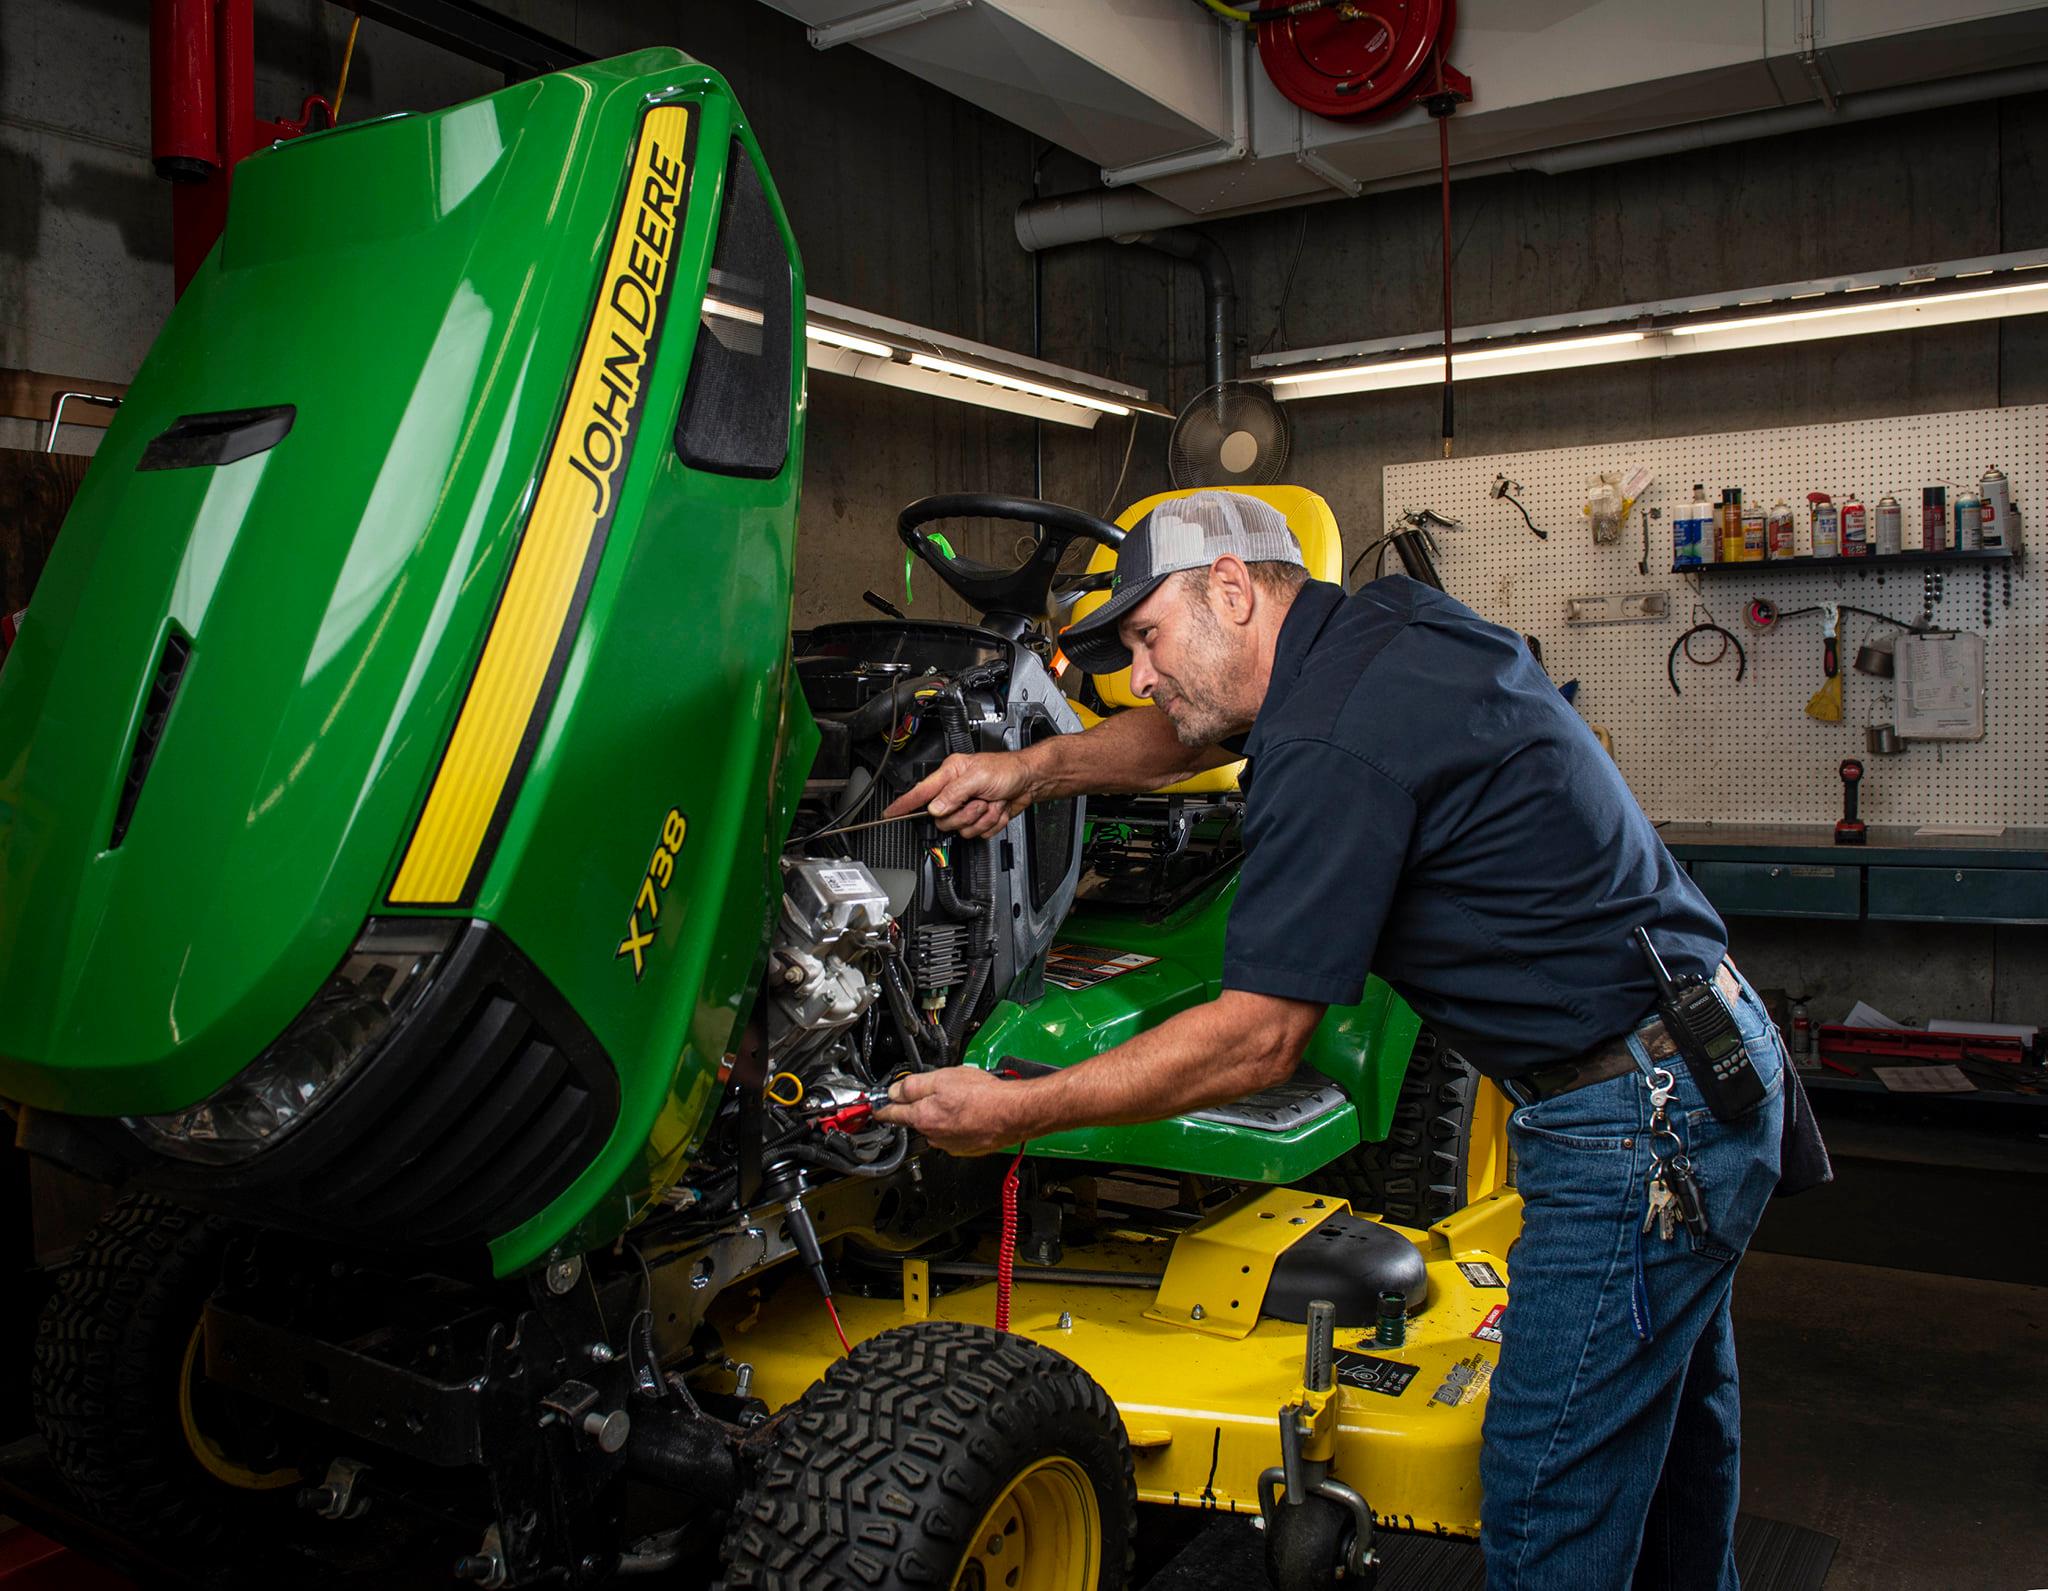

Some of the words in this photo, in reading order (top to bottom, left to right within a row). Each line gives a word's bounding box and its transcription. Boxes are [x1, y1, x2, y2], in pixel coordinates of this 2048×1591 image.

[568, 331, 643, 515] JOHN
[612, 140, 684, 337] DEERE
[616, 807, 688, 981] X738
[1432, 1363, 1476, 1408] EDGE
